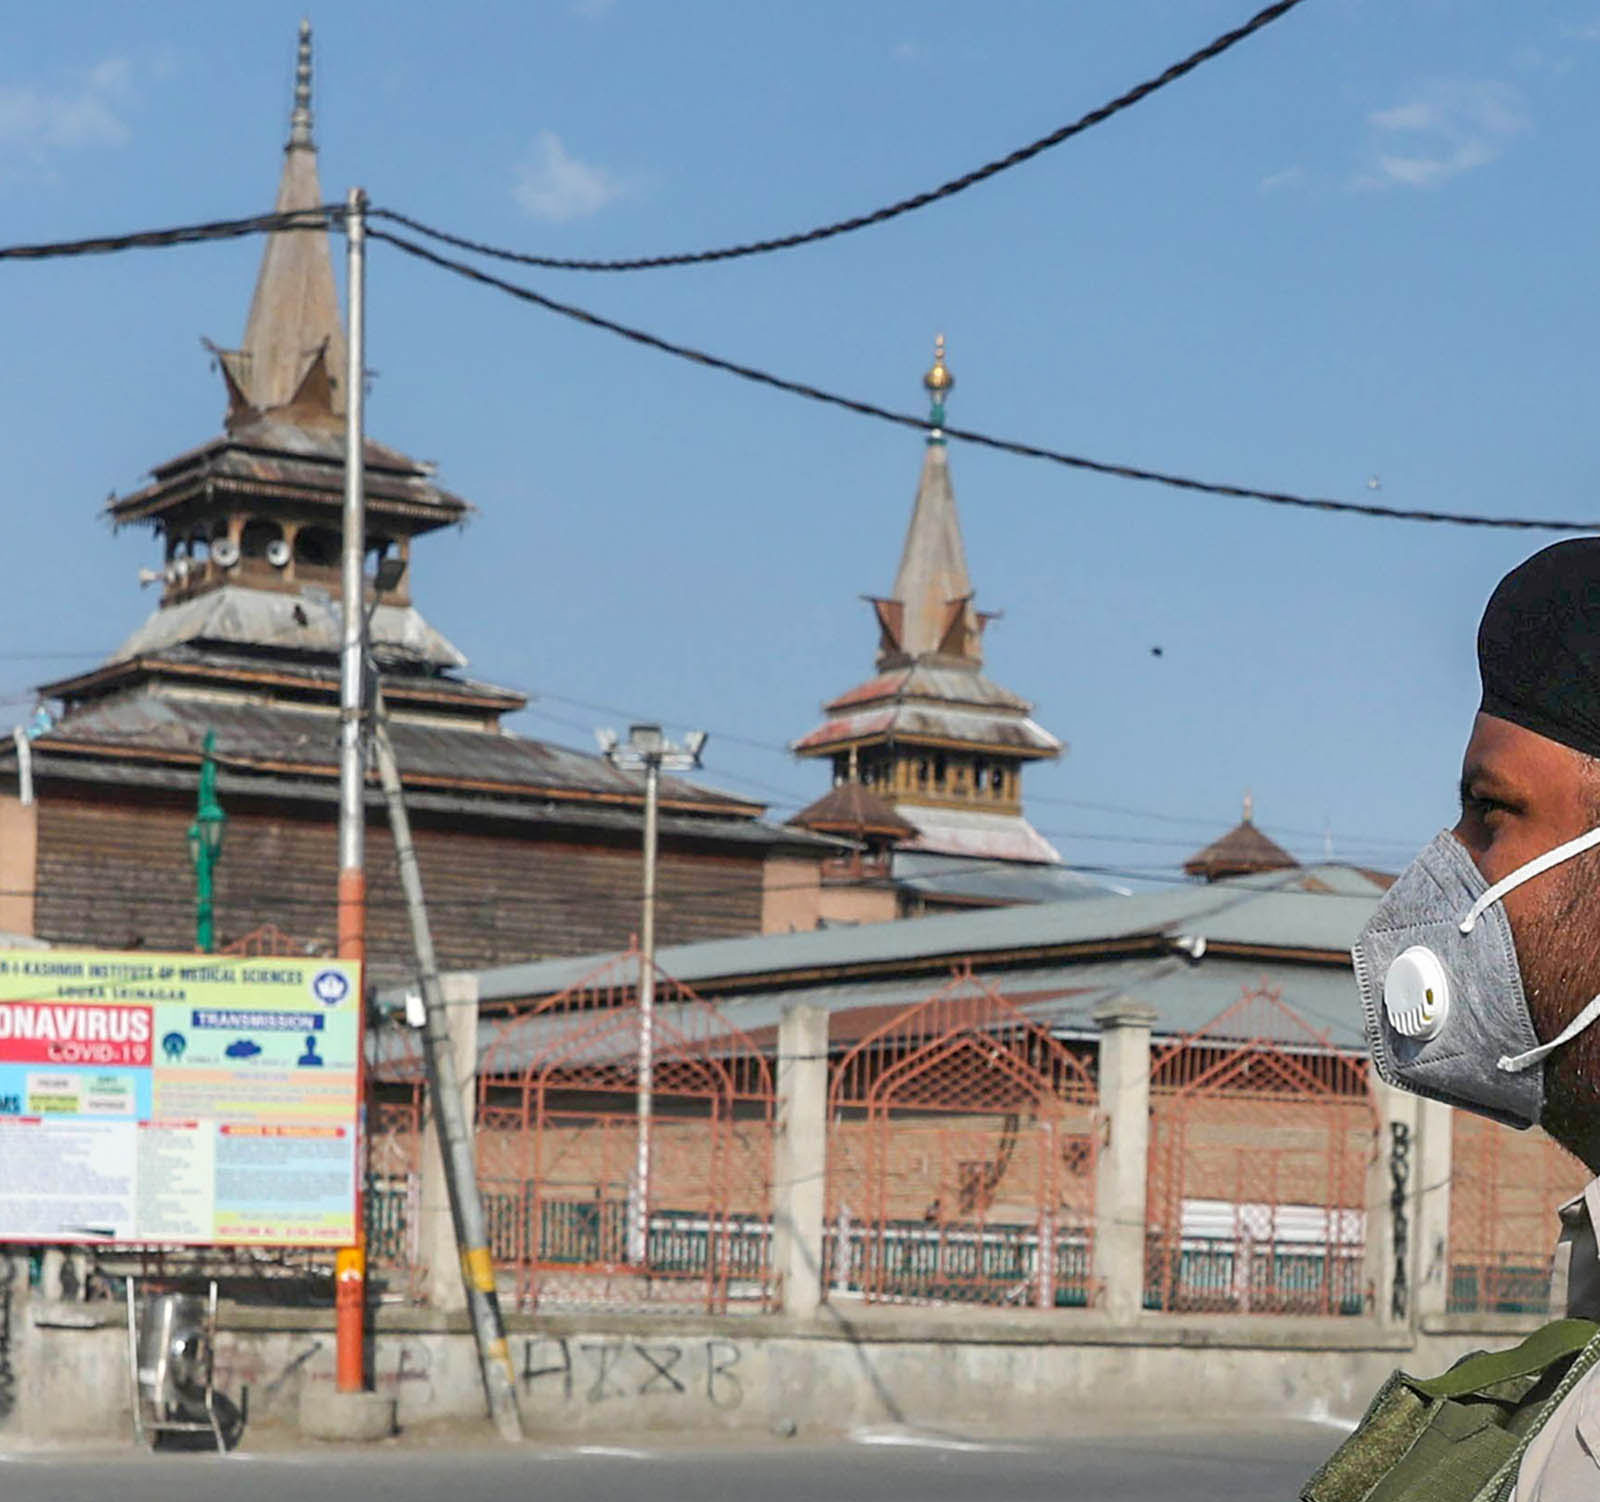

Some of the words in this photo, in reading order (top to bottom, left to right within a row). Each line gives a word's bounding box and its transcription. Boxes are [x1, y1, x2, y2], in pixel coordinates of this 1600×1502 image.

[242, 969, 304, 986] SCIENCES
[198, 1012, 316, 1030] TRANSMISSION
[47, 1041, 148, 1063] COVID-19
